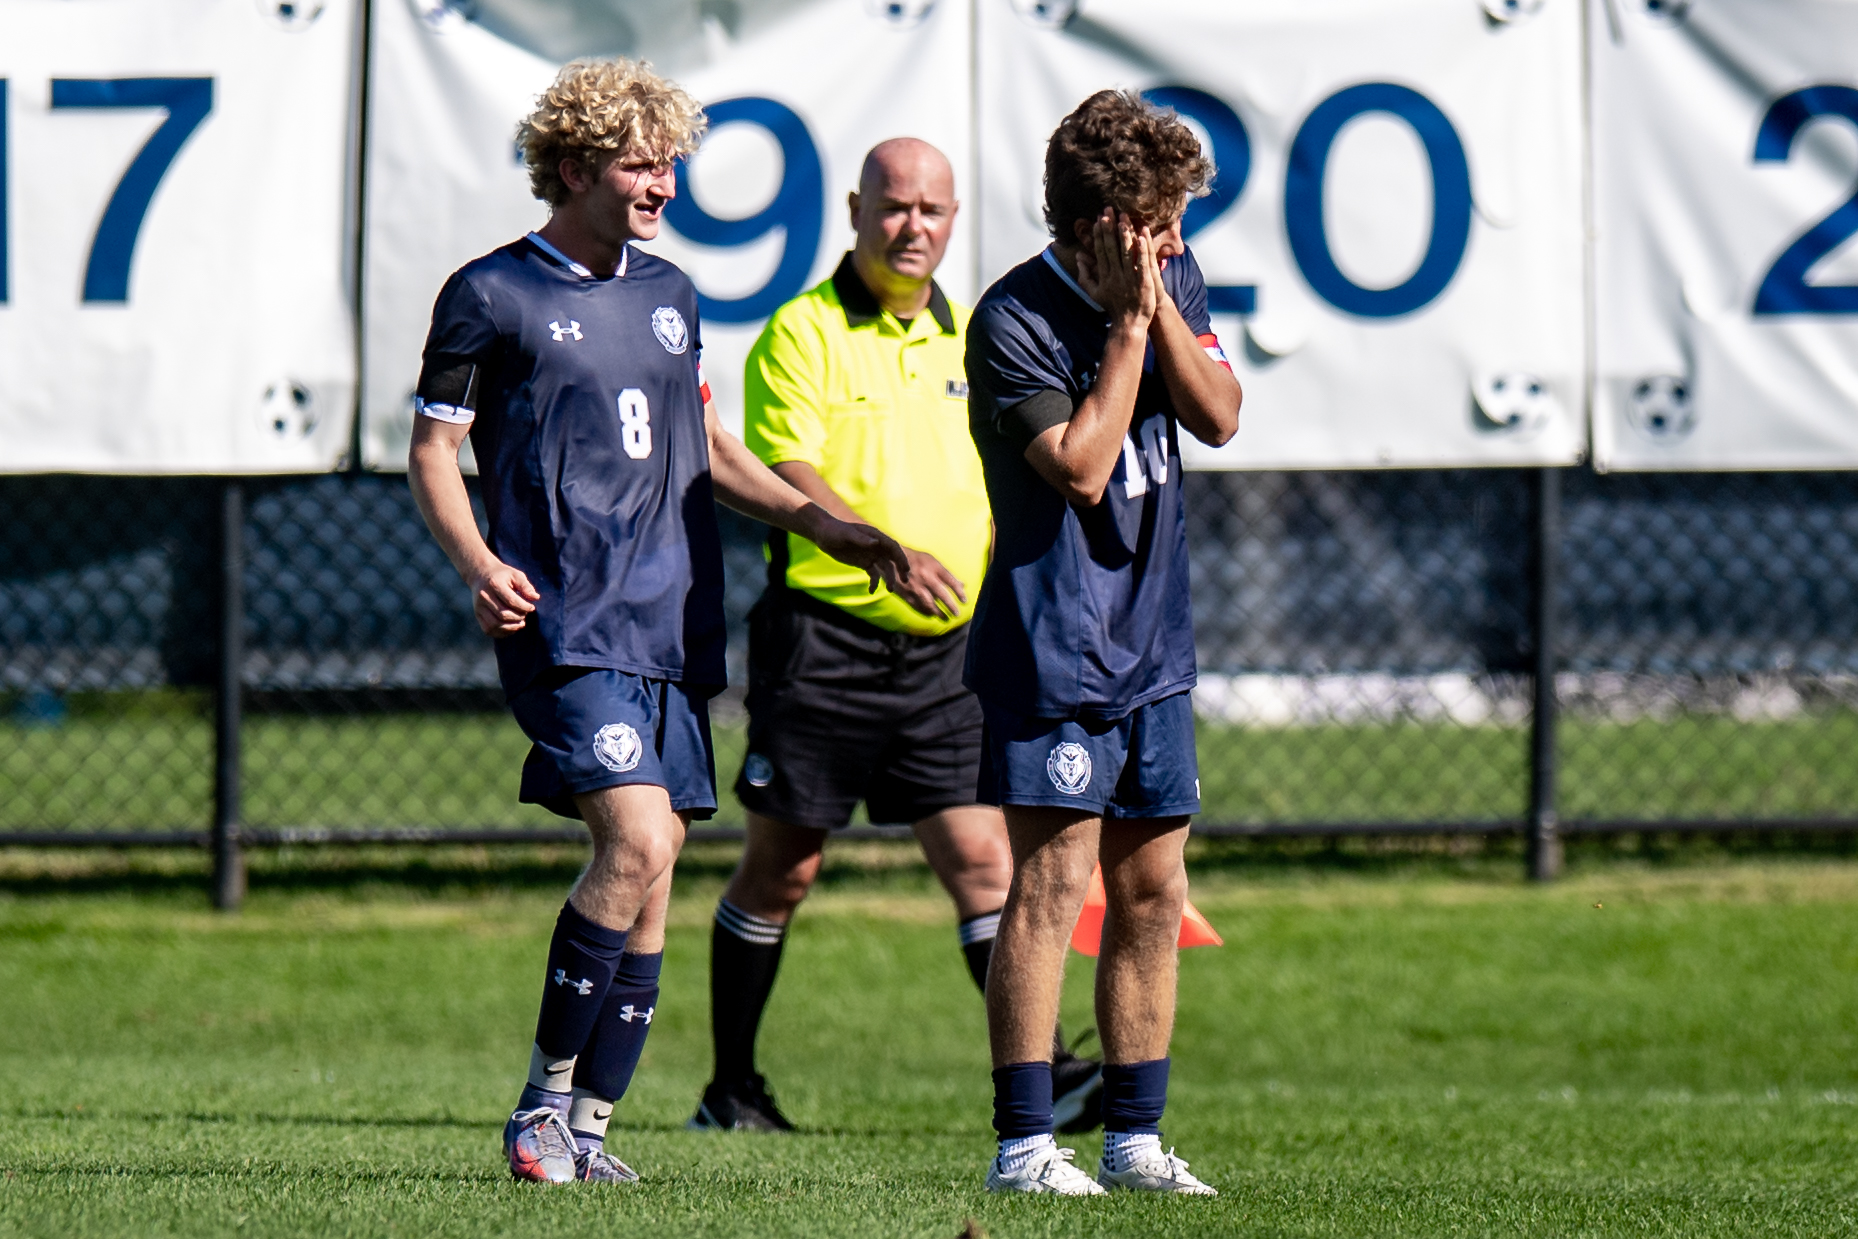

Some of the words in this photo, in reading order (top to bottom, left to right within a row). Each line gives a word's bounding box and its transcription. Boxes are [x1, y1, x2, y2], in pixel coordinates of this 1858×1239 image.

[0, 77, 214, 304] 7
[516, 96, 823, 325] 9
[618, 388, 653, 459] 8
[1122, 412, 1168, 499] 10
